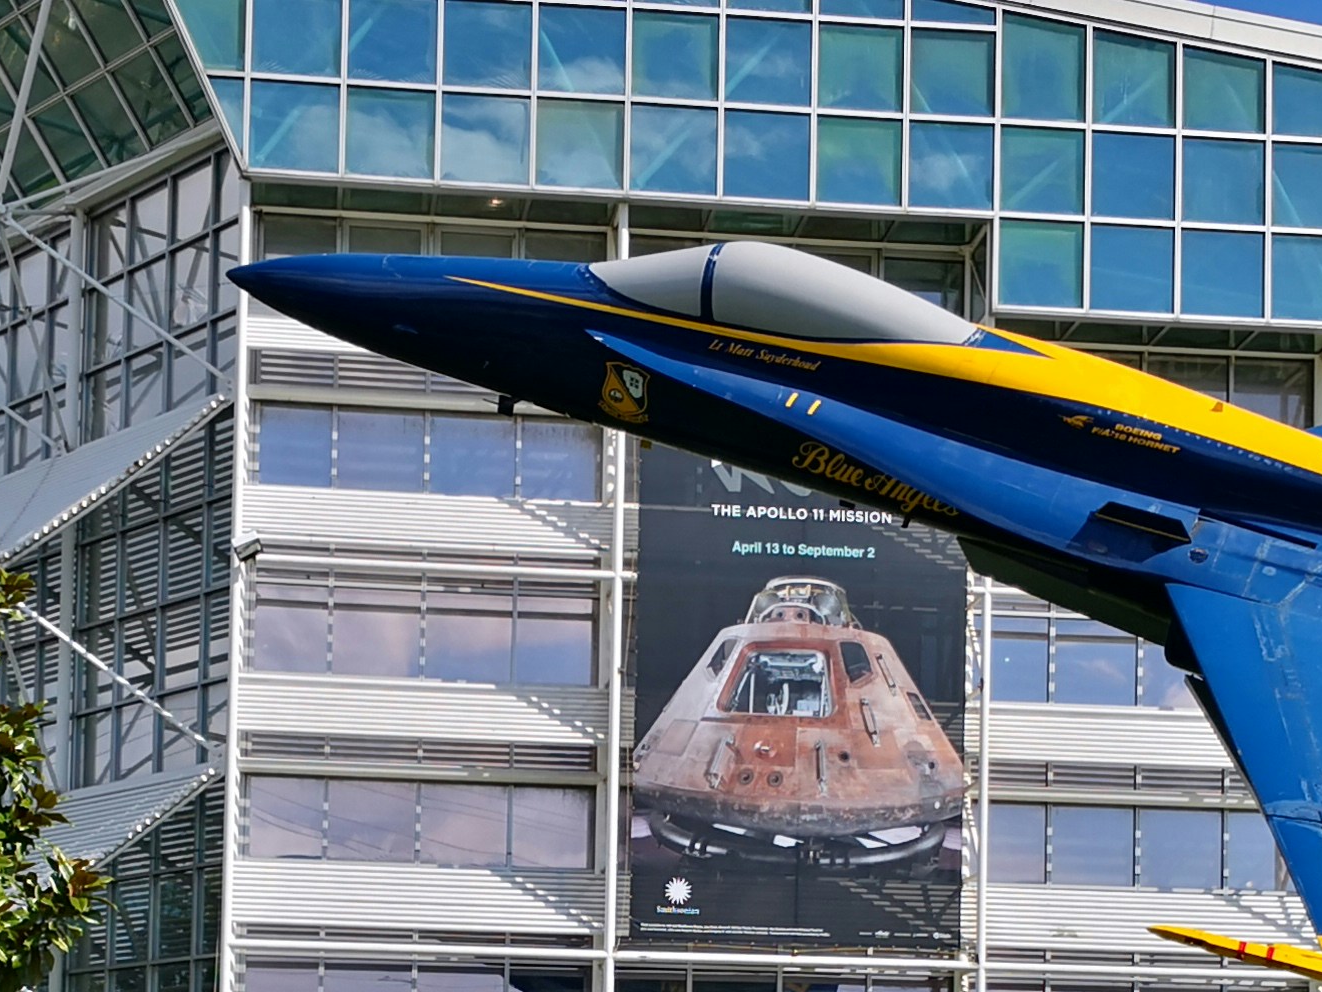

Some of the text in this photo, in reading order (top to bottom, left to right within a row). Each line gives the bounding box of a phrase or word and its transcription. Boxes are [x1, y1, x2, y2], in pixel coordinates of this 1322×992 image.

[725, 342, 755, 357] Matt
[1114, 423, 1163, 441] BOEING
[1127, 435, 1181, 454] HORNET
[792, 441, 865, 487] Blue
[711, 504, 892, 524] THE APOLLO 11 MISSION
[732, 540, 876, 559] April 13 to September 2
